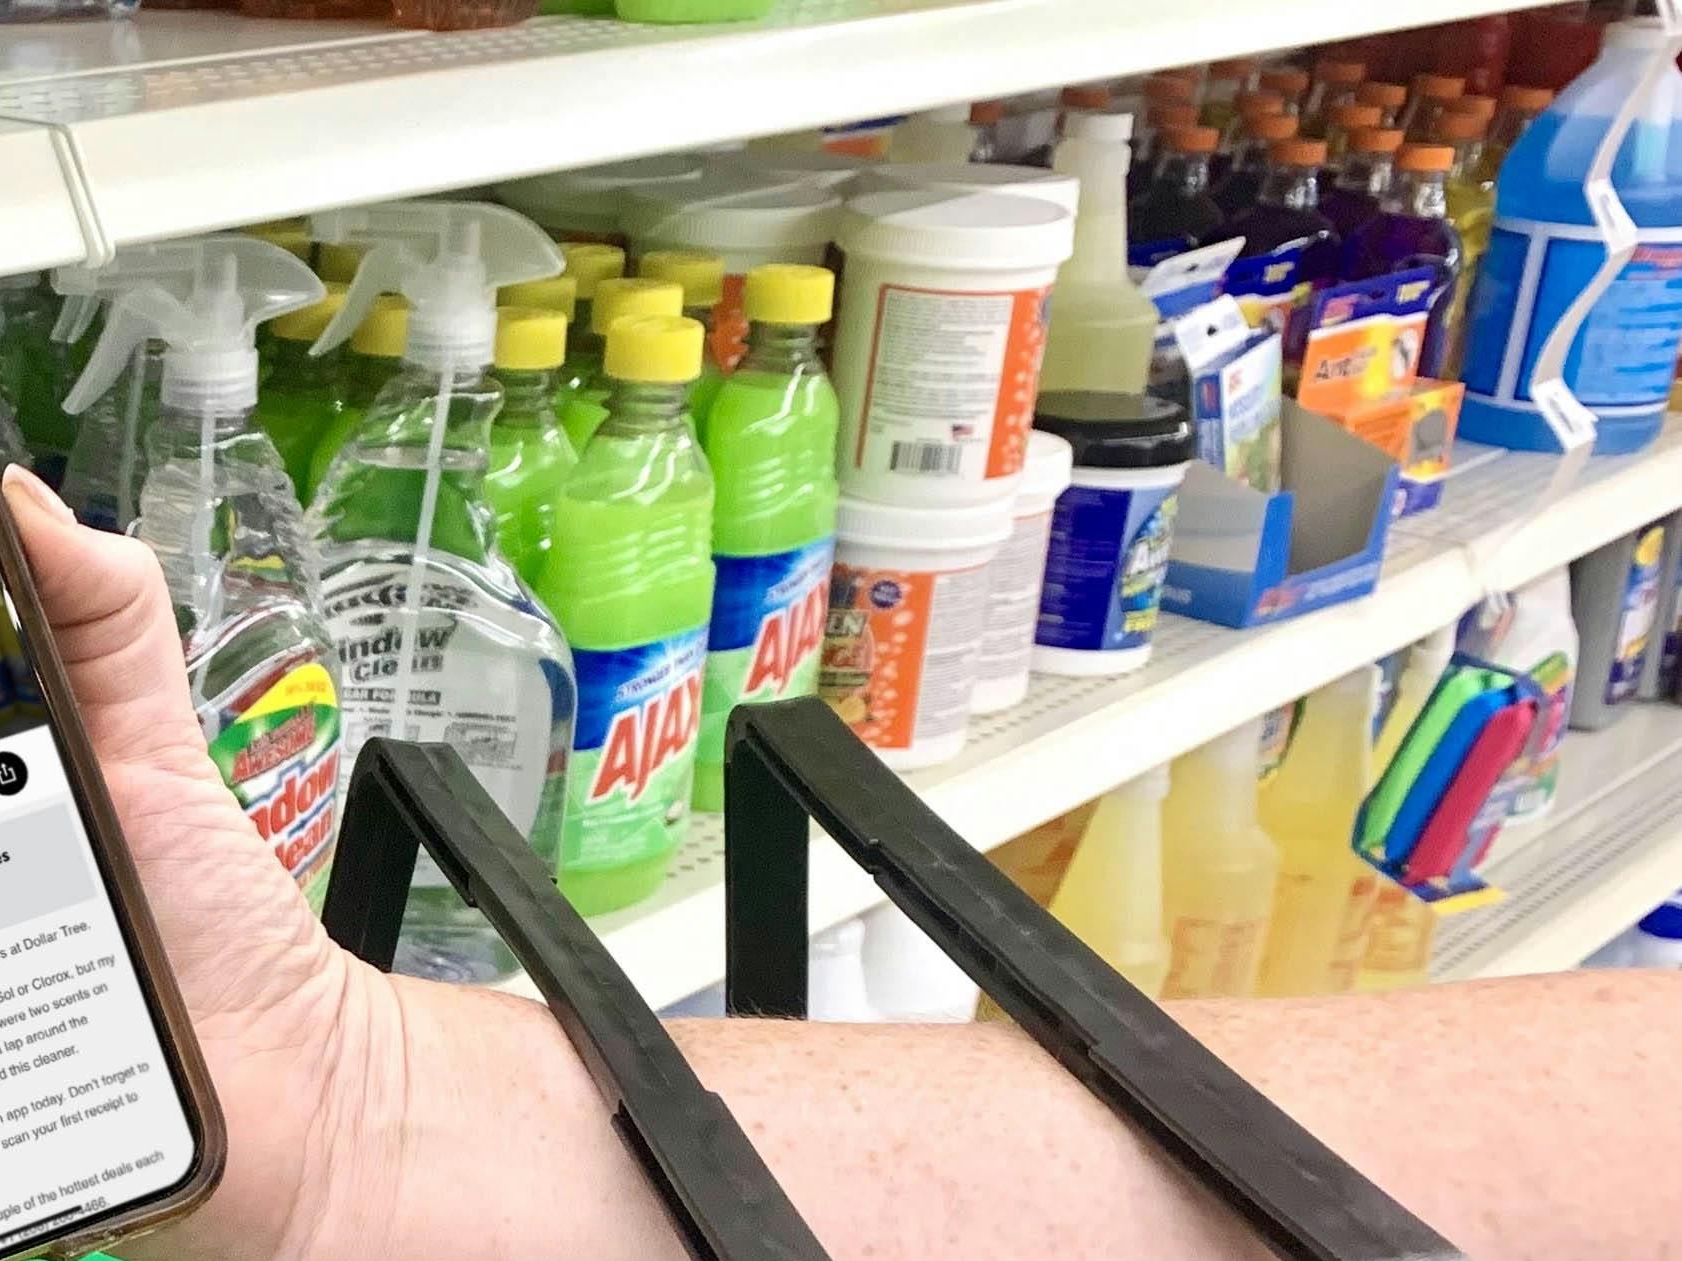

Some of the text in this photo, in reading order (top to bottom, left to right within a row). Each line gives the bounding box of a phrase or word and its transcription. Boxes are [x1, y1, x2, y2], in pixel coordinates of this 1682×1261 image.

[742, 580, 828, 696] AJA
[7, 940, 23, 956] at
[20, 930, 58, 951] Dollar
[57, 920, 92, 938] Tree.
[15, 982, 30, 997] or
[29, 968, 75, 992] Clorox,
[73, 958, 97, 977] but
[95, 953, 116, 969] my
